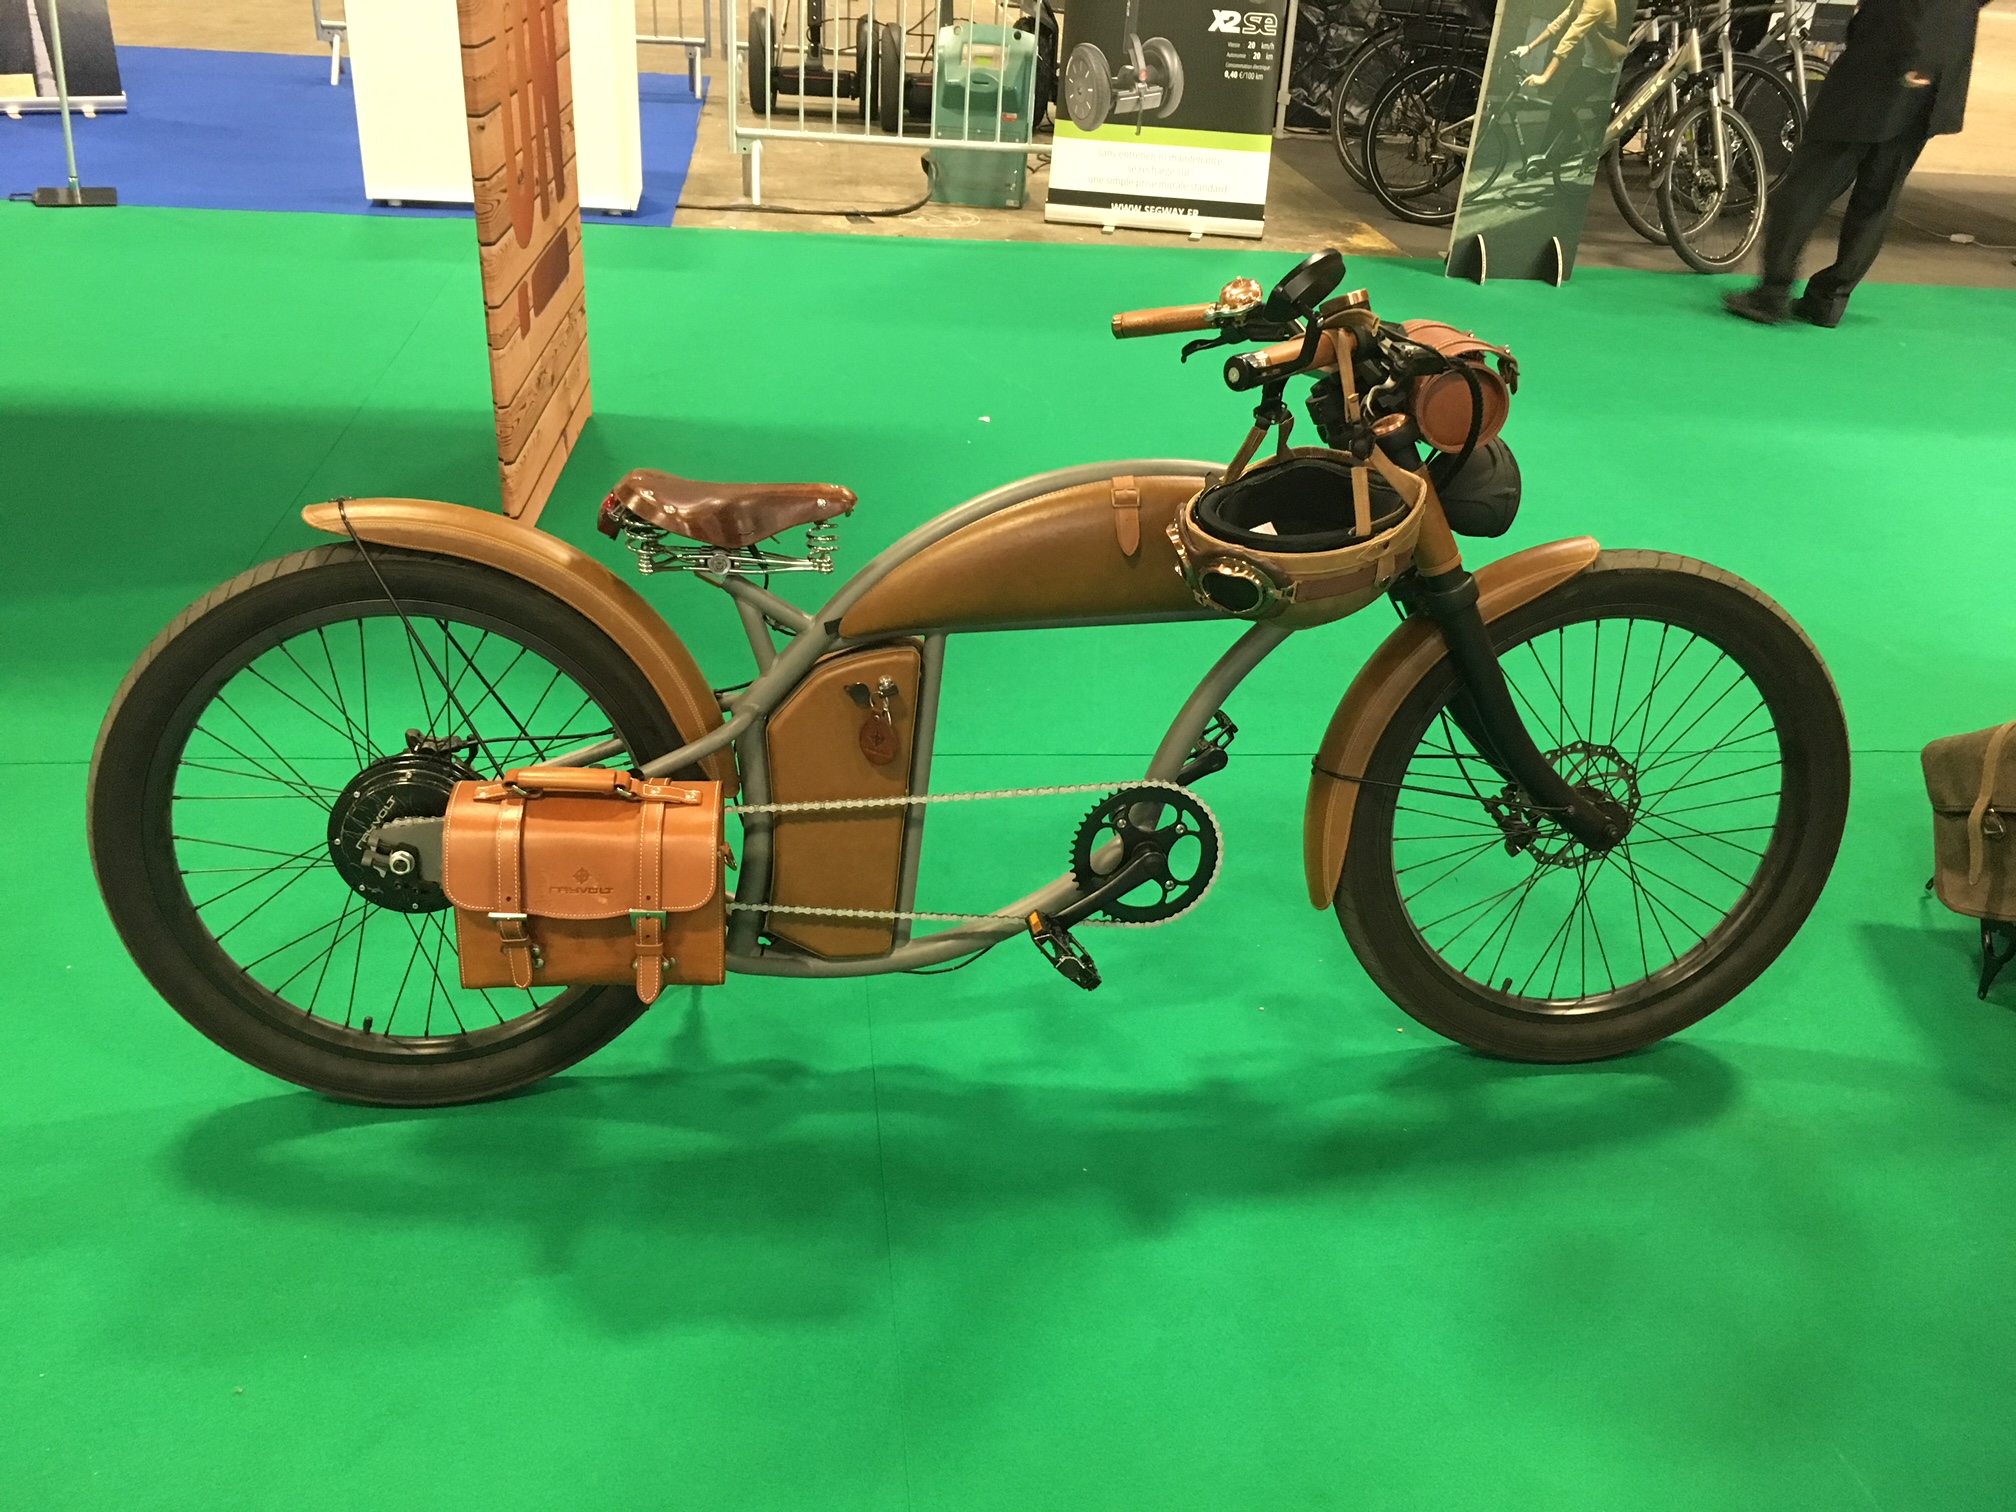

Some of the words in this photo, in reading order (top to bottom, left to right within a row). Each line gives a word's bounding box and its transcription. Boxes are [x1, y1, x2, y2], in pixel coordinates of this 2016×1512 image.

[1247, 41, 1256, 49] 20
[1261, 41, 1275, 50] km/h
[1252, 52, 1261, 60] 20
[1224, 70, 1238, 79] 0,40
[1255, 72, 1264, 80] km
[1611, 74, 1666, 130] TREK
[1118, 150, 1156, 161] entretien
[1168, 154, 1223, 166] maintenance
[1138, 165, 1175, 178] recharge
[1177, 168, 1190, 177] sur
[1087, 175, 1104, 185] une
[1105, 176, 1134, 188] simple
[1135, 178, 1157, 189] prise
[1158, 180, 1189, 191] murale
[1190, 183, 1228, 194] standard
[1110, 202, 1199, 216] WWWSEGWAYFR
